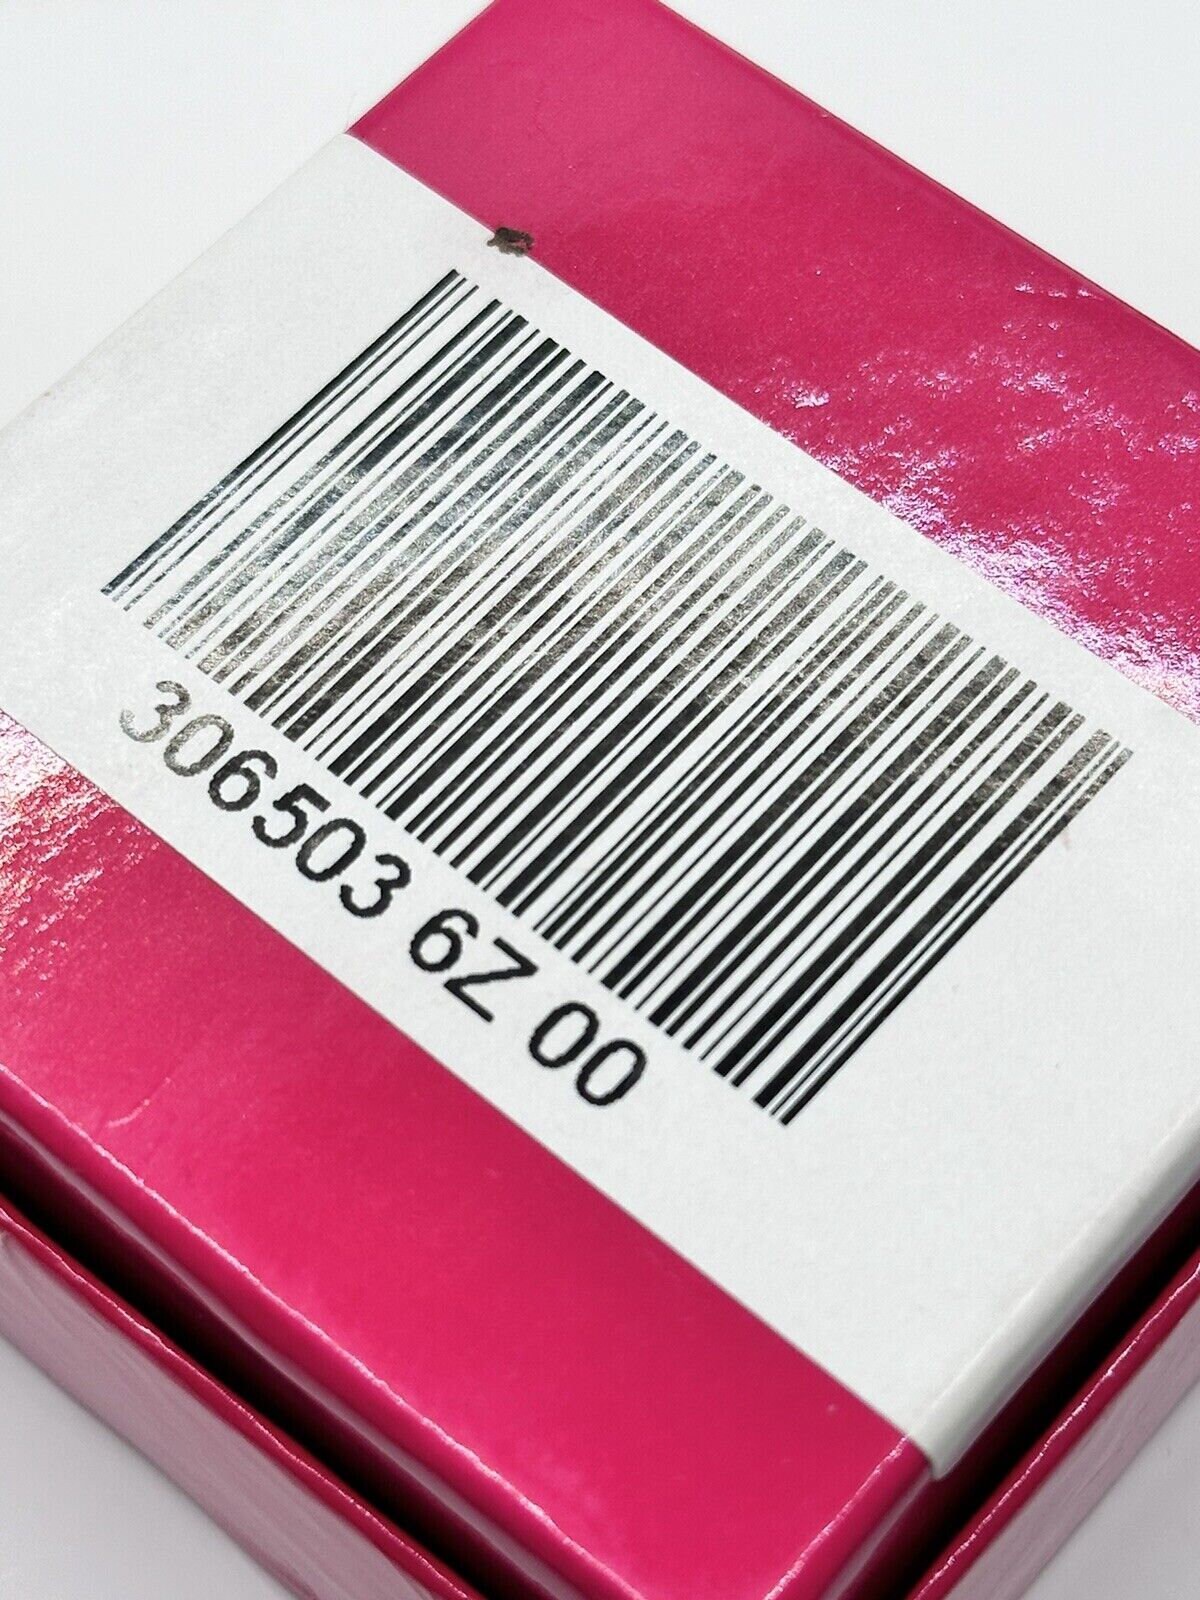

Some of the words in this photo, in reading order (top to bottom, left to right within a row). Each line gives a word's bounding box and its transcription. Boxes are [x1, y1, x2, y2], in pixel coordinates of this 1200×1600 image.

[119, 679, 412, 919] 306503
[408, 908, 539, 1023] 6Z
[527, 1001, 648, 1107] 00
